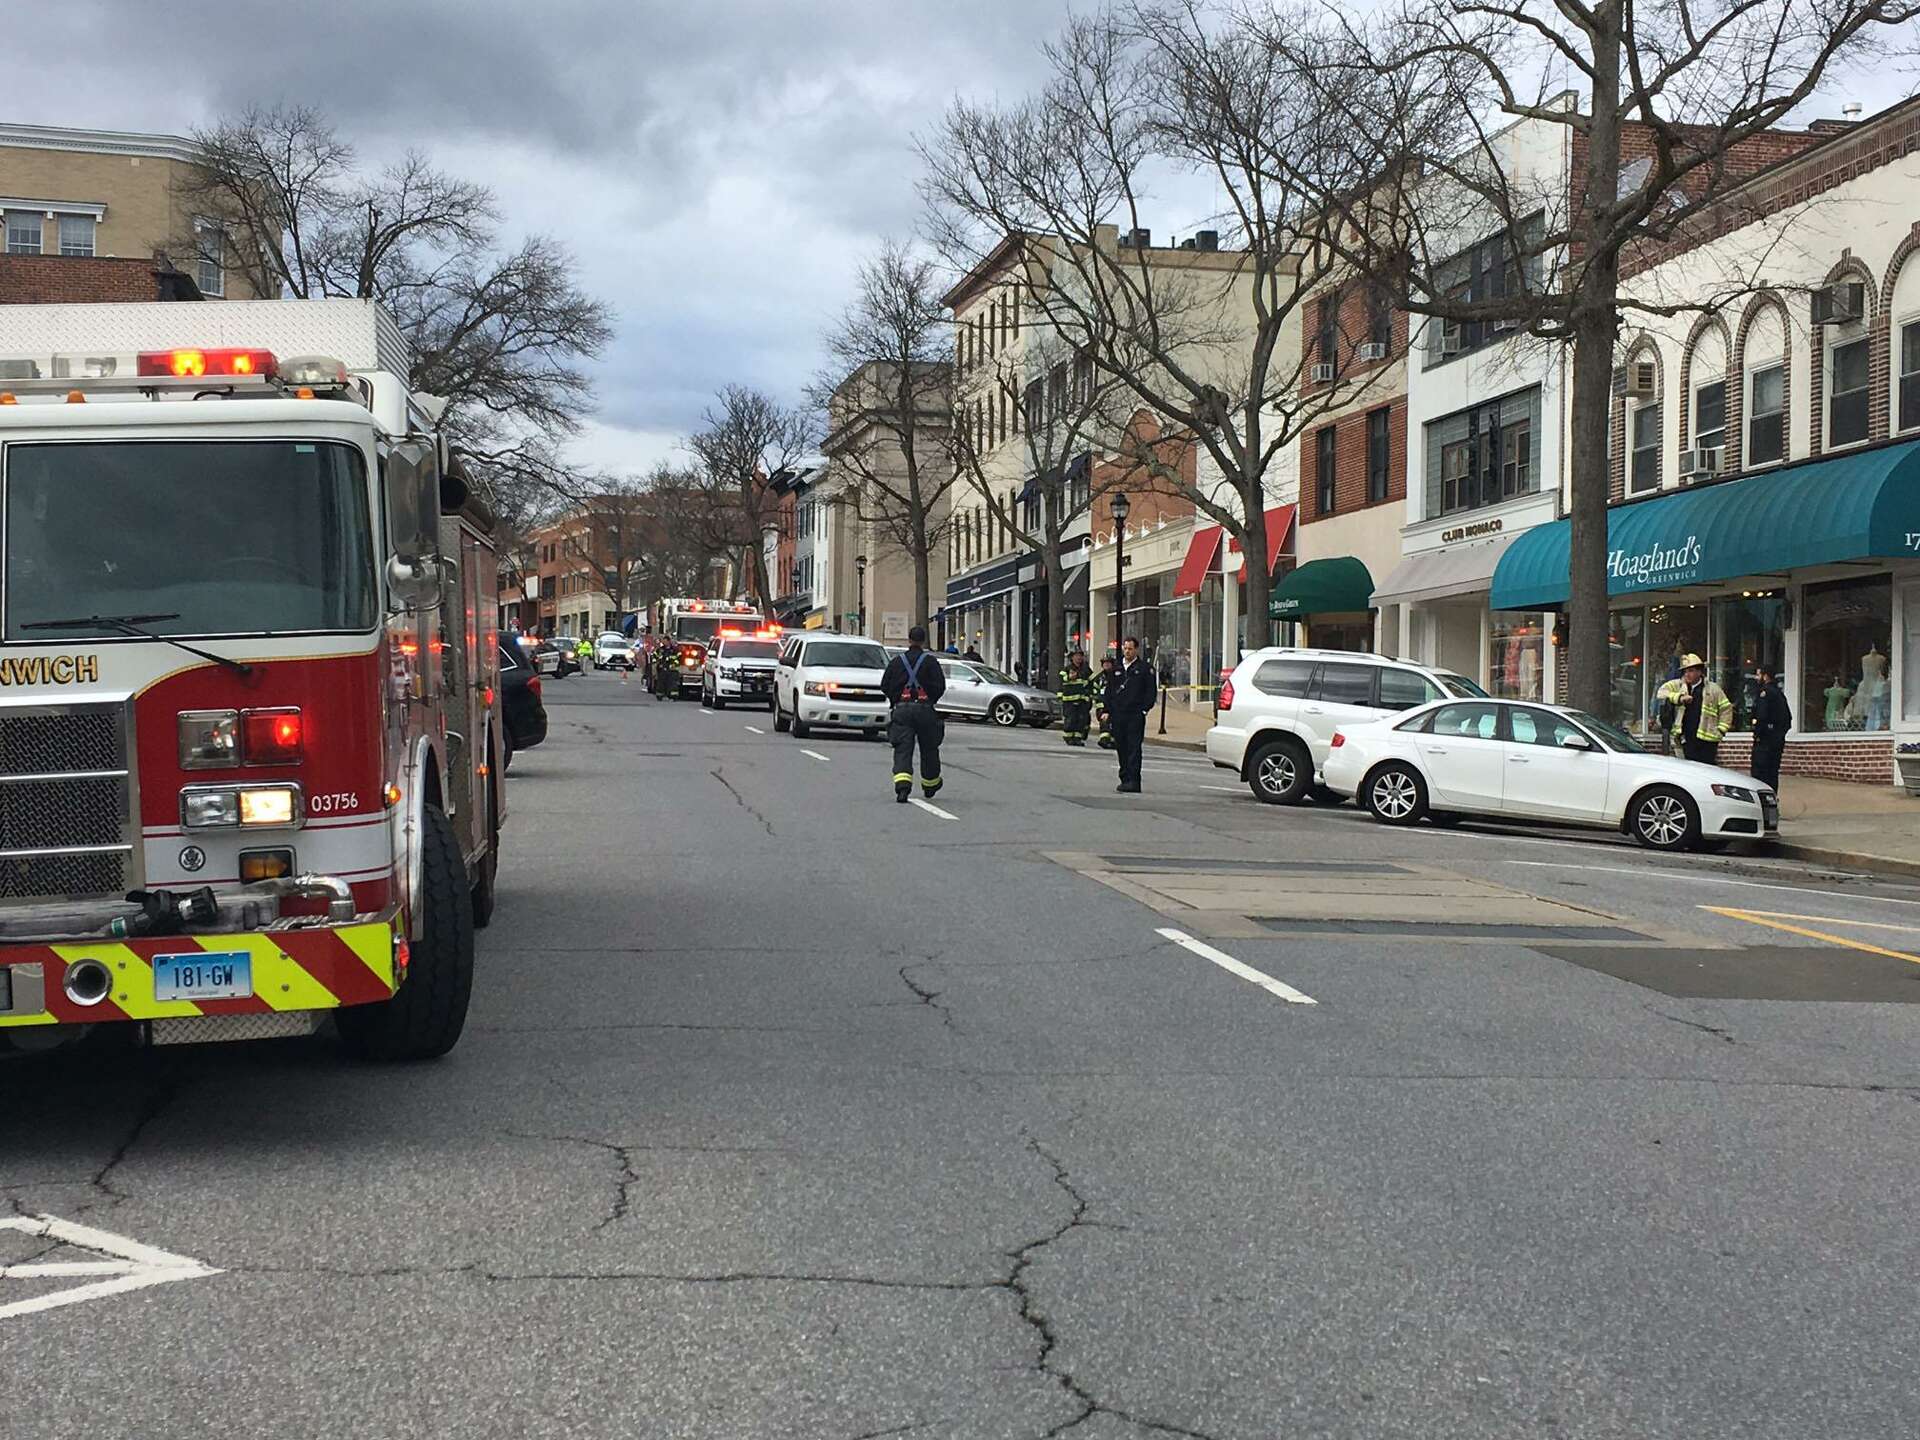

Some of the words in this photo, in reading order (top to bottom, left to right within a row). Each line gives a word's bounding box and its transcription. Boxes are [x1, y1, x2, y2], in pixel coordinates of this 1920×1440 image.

[1607, 535, 1701, 583] Hoagland's
[1646, 570, 1696, 585] GREENWICH
[311, 792, 359, 812] 03756
